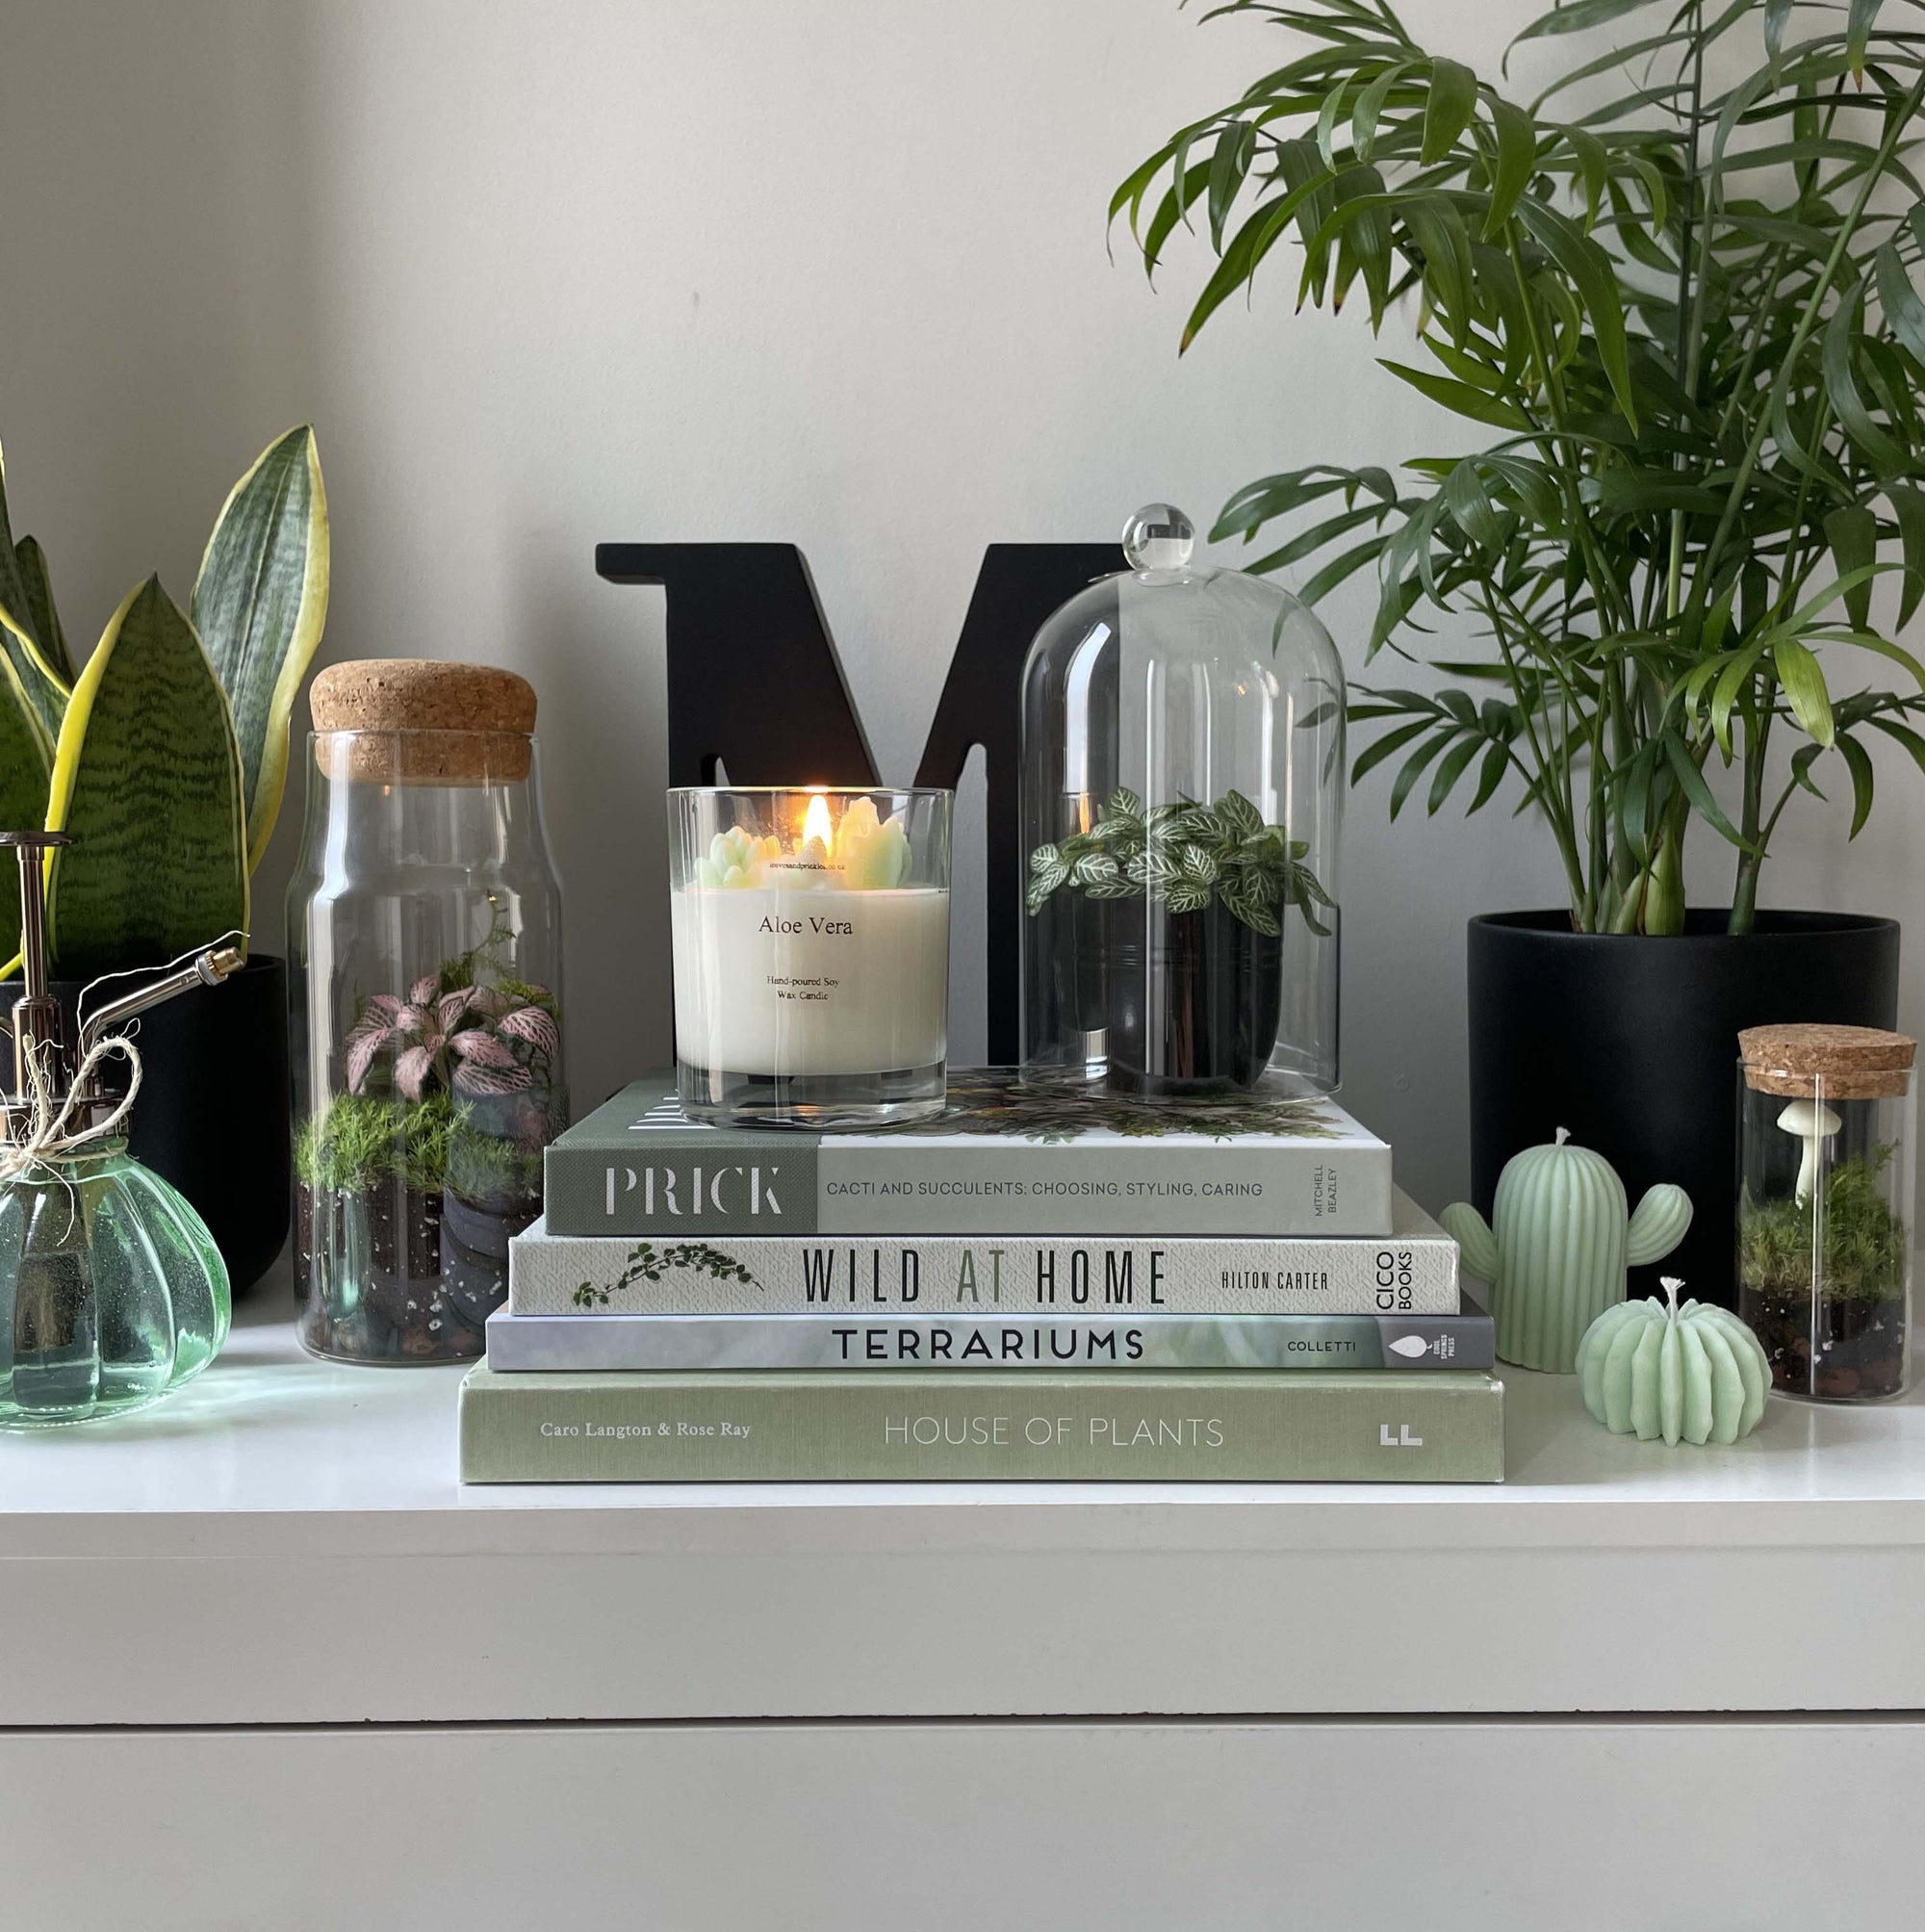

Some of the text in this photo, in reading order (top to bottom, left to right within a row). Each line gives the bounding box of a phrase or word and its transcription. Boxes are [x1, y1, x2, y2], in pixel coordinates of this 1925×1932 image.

[758, 915, 854, 935] Aloe Vera
[766, 975, 840, 988] Hand-poured Soy
[778, 990, 829, 1000] Wax Candle
[605, 1167, 783, 1216] PRICK
[827, 1181, 1263, 1198] CACTI AND SUCCULENTS: CHOOSING, STYLING, CARING
[1315, 1165, 1323, 1217] MITCHELL
[1328, 1168, 1337, 1213] BEAZLEY
[802, 1249, 1165, 1304] WILD AT HOME
[1221, 1271, 1328, 1291] HILTON CARTER
[1376, 1251, 1394, 1310] CICO
[1399, 1251, 1412, 1309] BOOKS
[831, 1328, 1143, 1360] TERRARIUMS
[1287, 1341, 1356, 1352] COLLETTI
[540, 1422, 751, 1440] Caro Langton & Rose Ray
[885, 1416, 1223, 1447] HOUSE OF PLANTS
